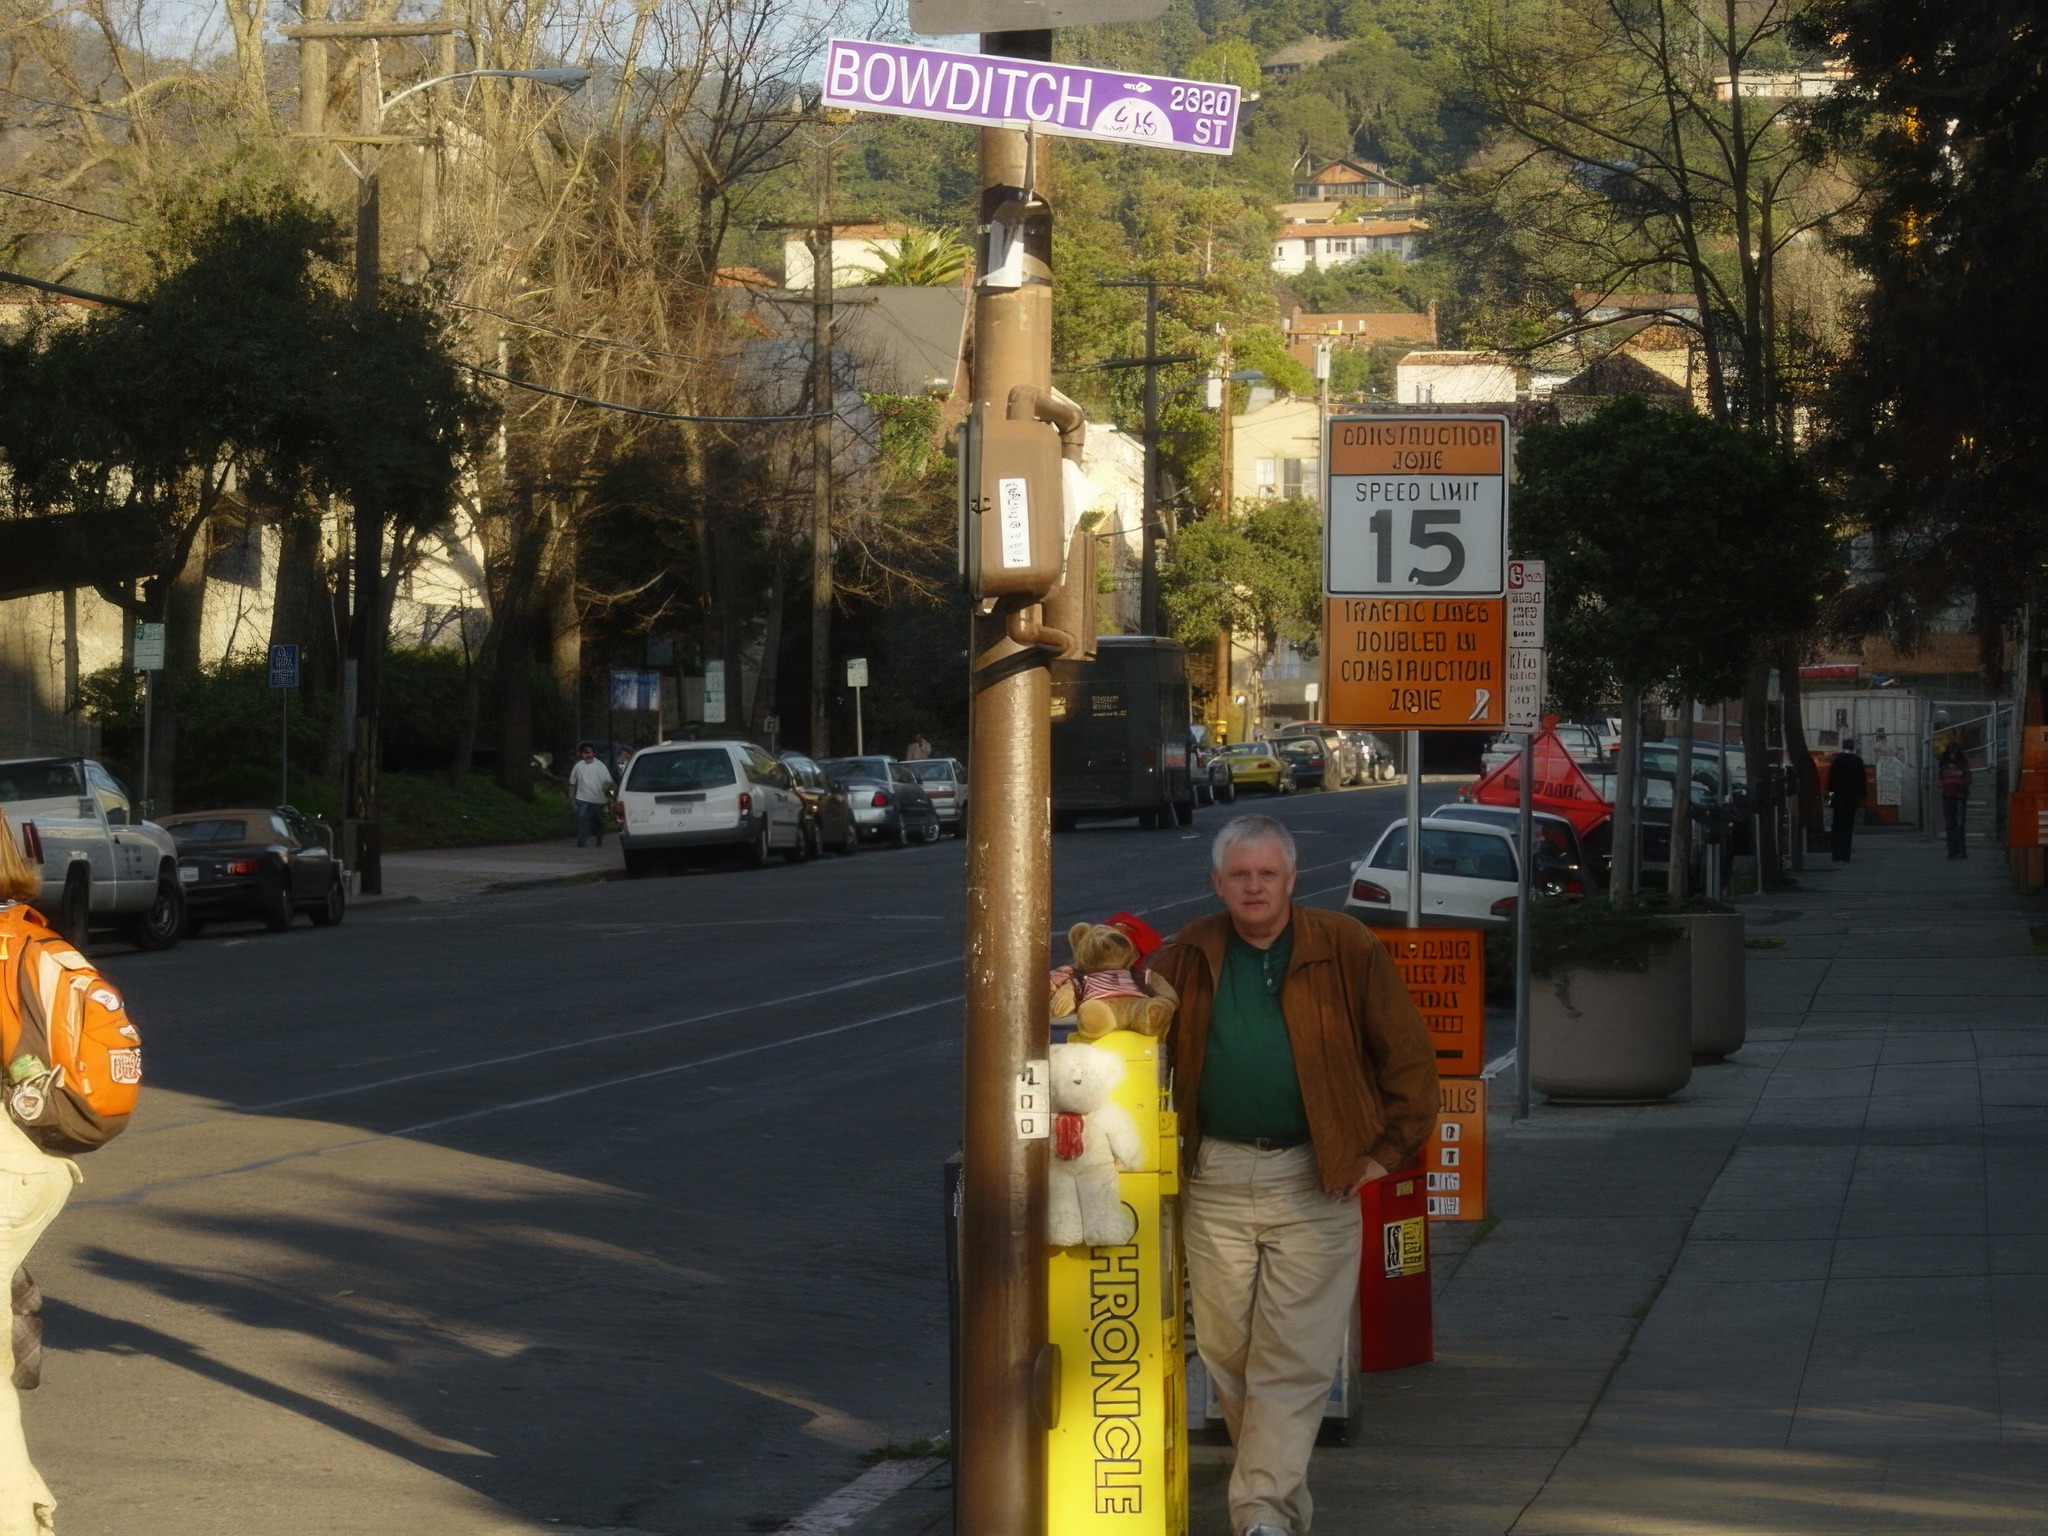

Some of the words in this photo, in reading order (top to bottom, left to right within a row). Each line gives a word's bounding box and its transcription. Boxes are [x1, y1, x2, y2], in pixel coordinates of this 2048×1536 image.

[830, 48, 1092, 126] BOWDITCH
[1193, 118, 1227, 145] ST
[1356, 482, 1420, 501] SPEED
[1430, 482, 1479, 501] LIMIT
[1369, 509, 1466, 587] 15
[1357, 631, 1447, 652] DOUBLED
[1341, 660, 1491, 682] CONSTRUCTION
